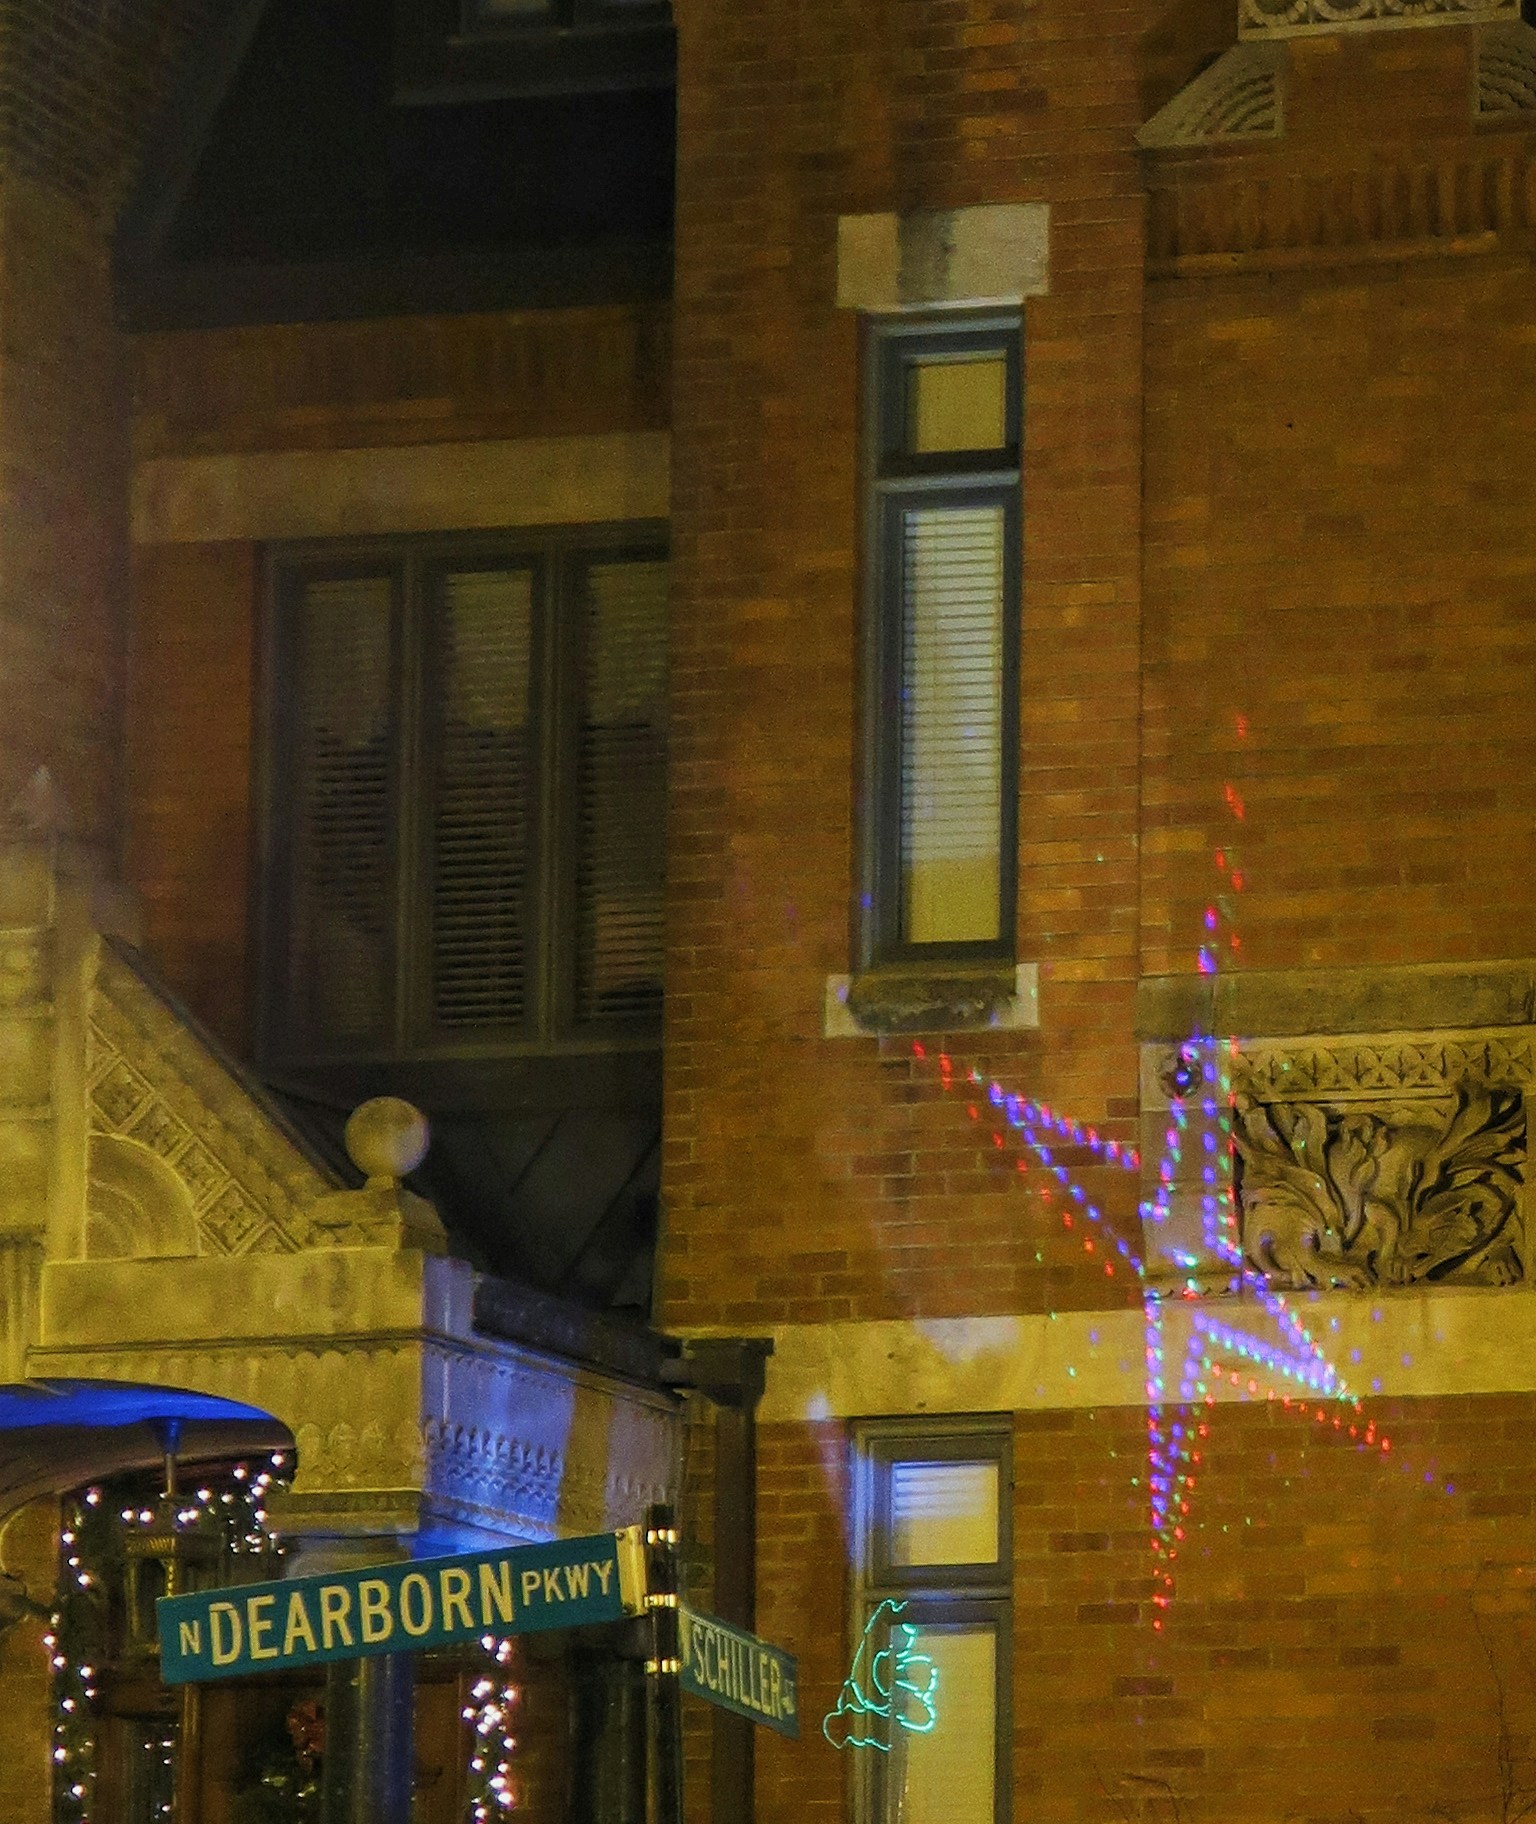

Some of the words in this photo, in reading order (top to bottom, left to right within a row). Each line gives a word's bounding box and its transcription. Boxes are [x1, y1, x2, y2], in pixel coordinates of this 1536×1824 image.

[180, 1619, 202, 1656] N
[209, 1561, 514, 1666] DEARBORN
[520, 1559, 614, 1607] PKWY
[692, 1622, 784, 1721] SCHILLER
